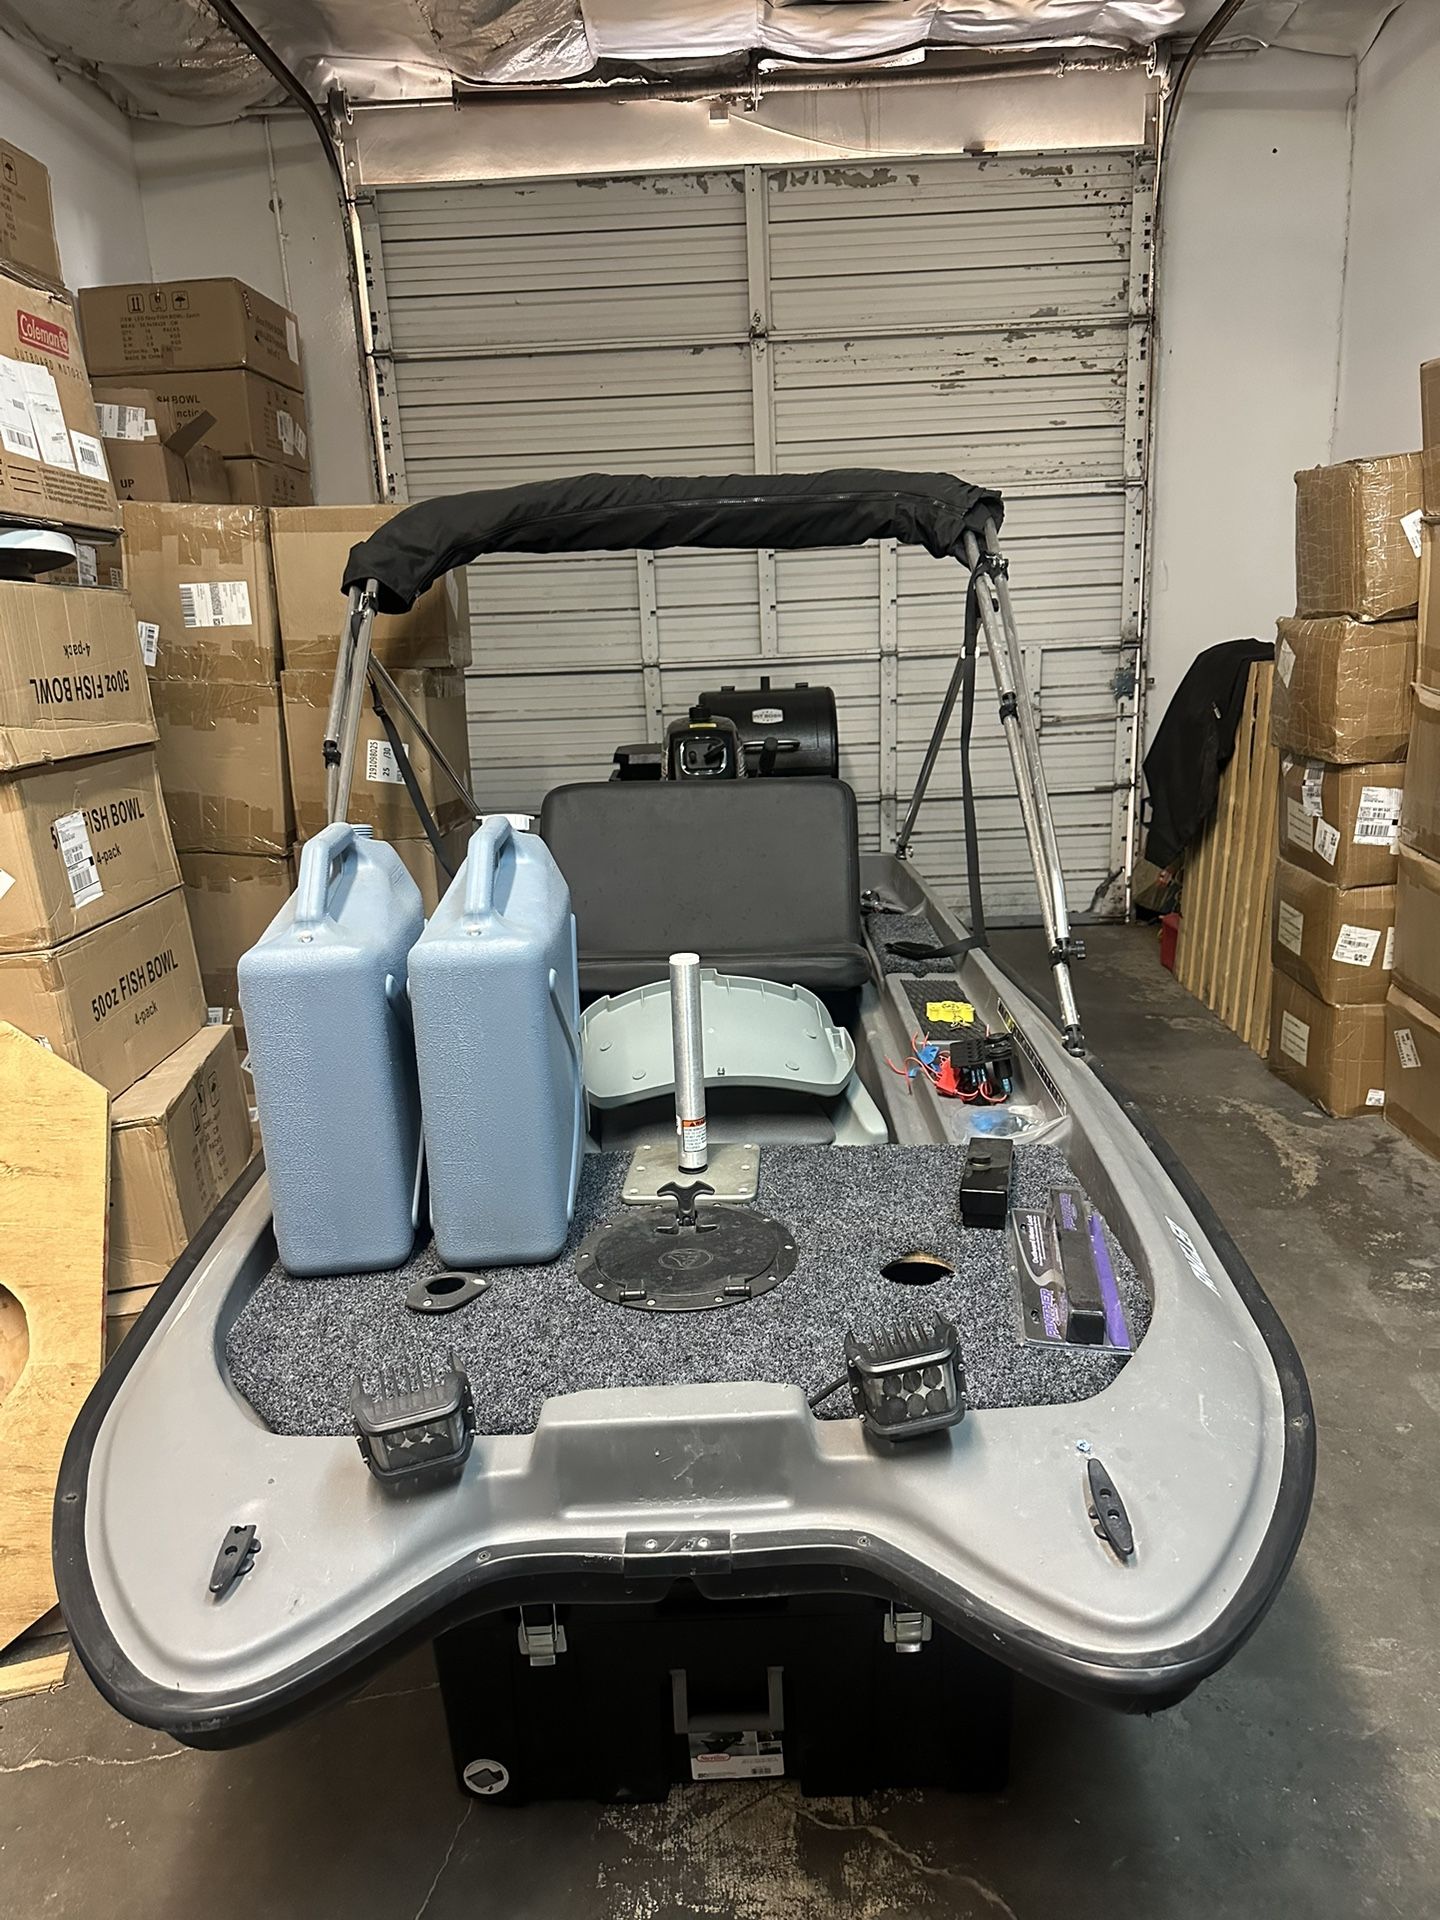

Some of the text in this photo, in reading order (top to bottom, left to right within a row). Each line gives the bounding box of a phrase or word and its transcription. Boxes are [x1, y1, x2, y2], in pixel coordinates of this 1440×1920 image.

[20, 313, 60, 349] Coleman
[171, 394, 201, 405] BOWL
[120, 479, 135, 489] UP
[63, 640, 91, 659] 4-pack
[29, 669, 130, 704] 50oz FISH BOWL
[382, 767, 390, 777] 25
[109, 797, 145, 827] BOWL
[96, 843, 122, 866] 4-pack
[91, 949, 179, 1022] 50oz FISH BOWL
[134, 1001, 159, 1026] 4-pack
[1039, 1287, 1062, 1340] PANTHER
